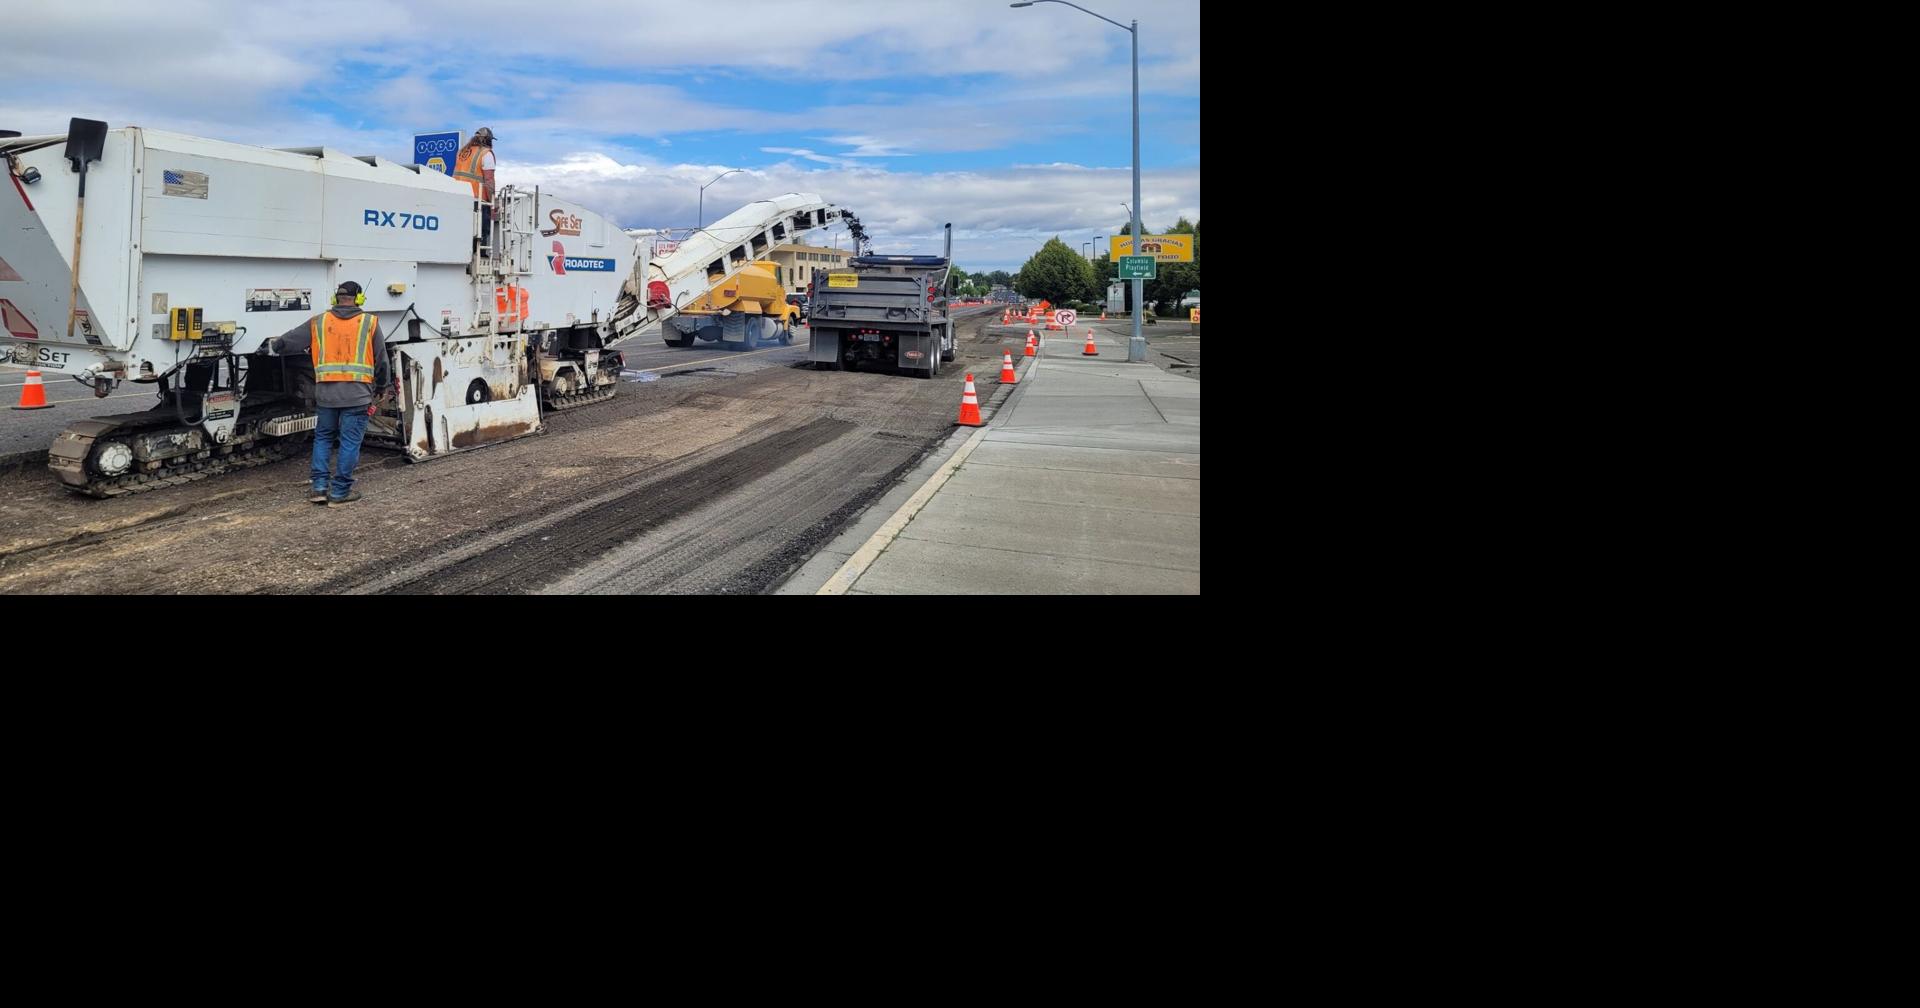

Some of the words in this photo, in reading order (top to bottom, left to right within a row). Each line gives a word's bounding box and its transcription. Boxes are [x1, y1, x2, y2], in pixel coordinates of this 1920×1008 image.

[364, 209, 396, 228] RX
[399, 212, 439, 231] 700
[565, 259, 604, 269] ROADTEC
